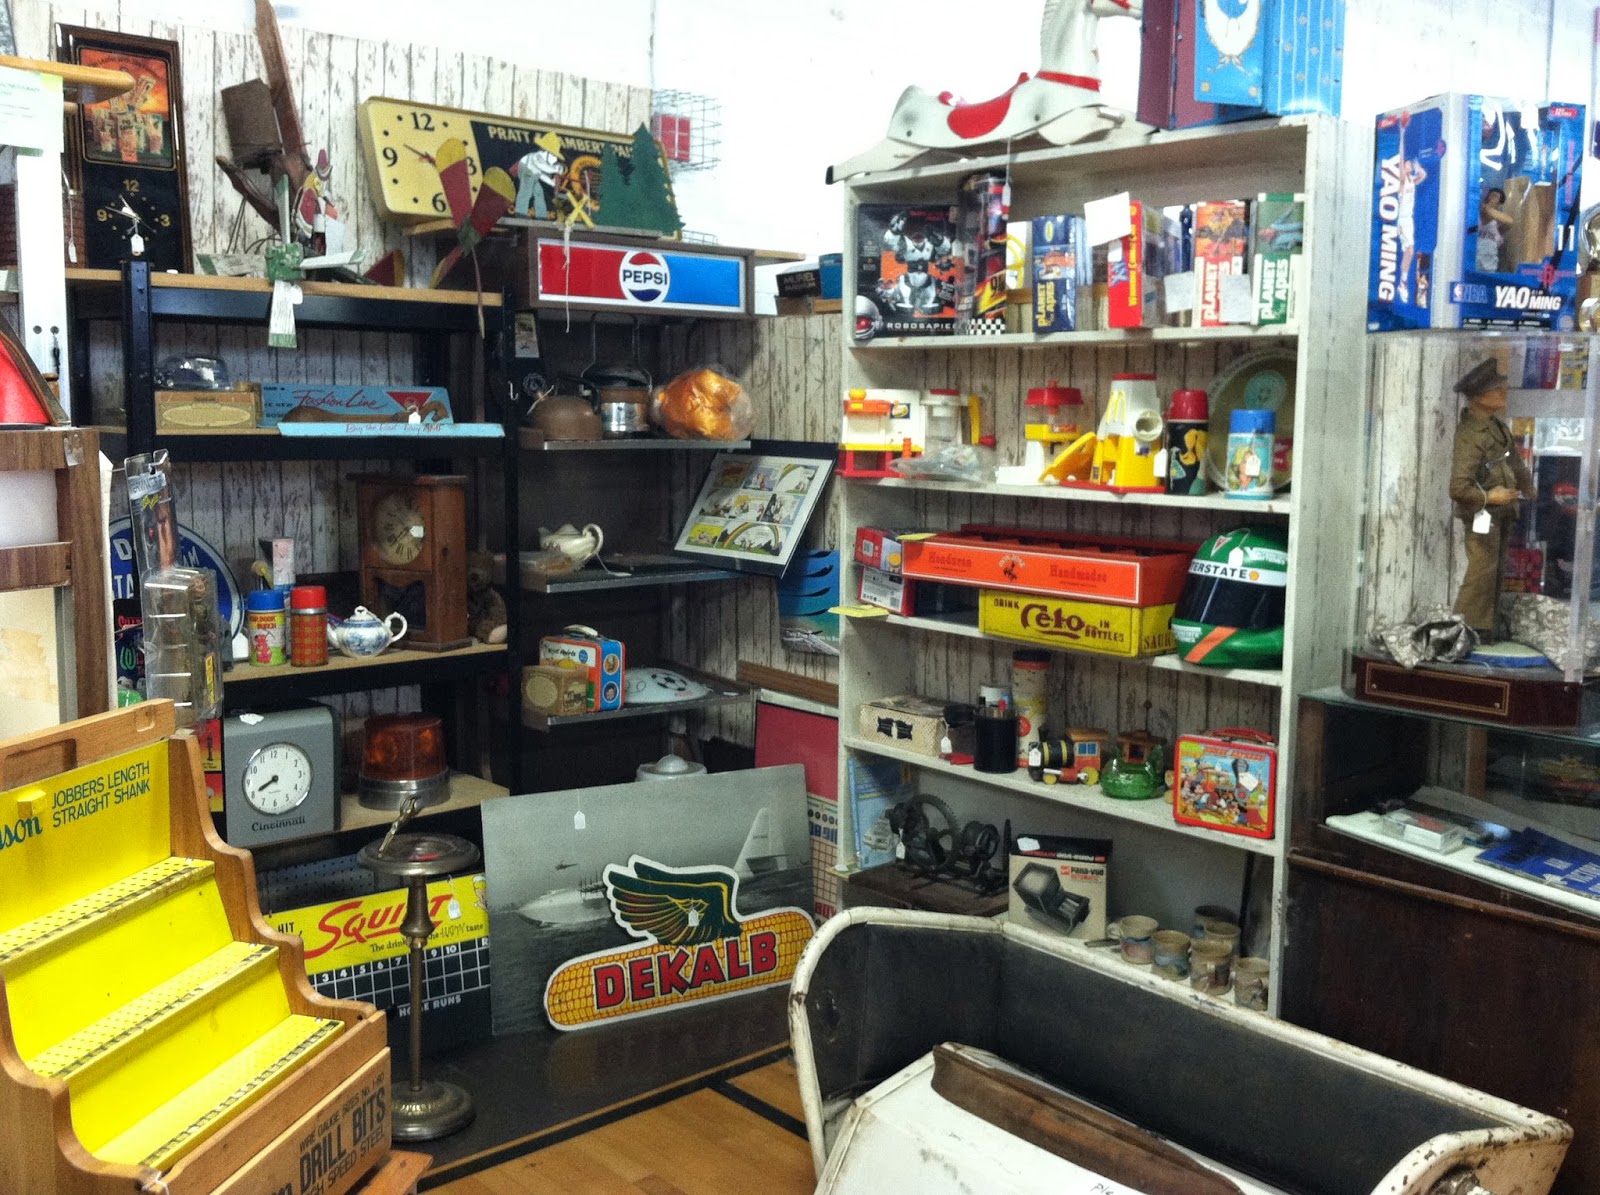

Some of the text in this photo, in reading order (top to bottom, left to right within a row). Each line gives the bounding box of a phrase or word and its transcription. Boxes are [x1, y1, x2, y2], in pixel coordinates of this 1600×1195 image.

[410, 111, 435, 132] 12
[487, 125, 531, 144] PRATT
[382, 147, 398, 168] 9
[465, 156, 477, 176] 3
[123, 180, 140, 193] 12
[1378, 153, 1401, 222] YAO
[431, 192, 447, 213] 6
[97, 208, 108, 222] 9
[160, 213, 171, 227] 3
[1557, 224, 1575, 252] 11
[1378, 223, 1398, 302] MING
[622, 269, 668, 286] PEPSI
[1275, 258, 1289, 301] APES
[1258, 258, 1276, 320] PLANET
[1495, 285, 1531, 308] YAO
[1528, 295, 1562, 311] MING
[993, 598, 1020, 609] DRINK
[1099, 619, 1110, 628] IN
[1084, 624, 1125, 643] BOTTLES
[270, 750, 278, 759] 12
[293, 759, 298, 768] 2
[250, 765, 258, 775] 10
[297, 771, 303, 779] 3
[52, 761, 150, 810] JOBBERS LENGTH
[293, 783, 298, 792] 4
[52, 779, 151, 828] STRAIGHT SHANK
[251, 791, 256, 800] 8
[261, 797, 266, 807] 7
[273, 798, 278, 807] 6
[285, 793, 290, 802] 5
[251, 814, 307, 831] Cincinnati
[277, 922, 296, 934] HIT
[303, 894, 453, 960] SQUIT
[370, 944, 385, 953] The
[466, 923, 484, 932] taste
[322, 973, 330, 983] 3
[340, 969, 348, 978] 4
[359, 965, 366, 974] 5
[377, 961, 384, 970] 6
[395, 956, 403, 966] 7
[431, 949, 438, 958] 9
[445, 945, 457, 955] 10
[593, 931, 778, 1010] DEKALB
[399, 994, 462, 1017] HOE RUNS
[300, 1086, 386, 1194] DRILL BITS
[327, 1149, 358, 1189] SPEED
[360, 1123, 385, 1158] STEEL
